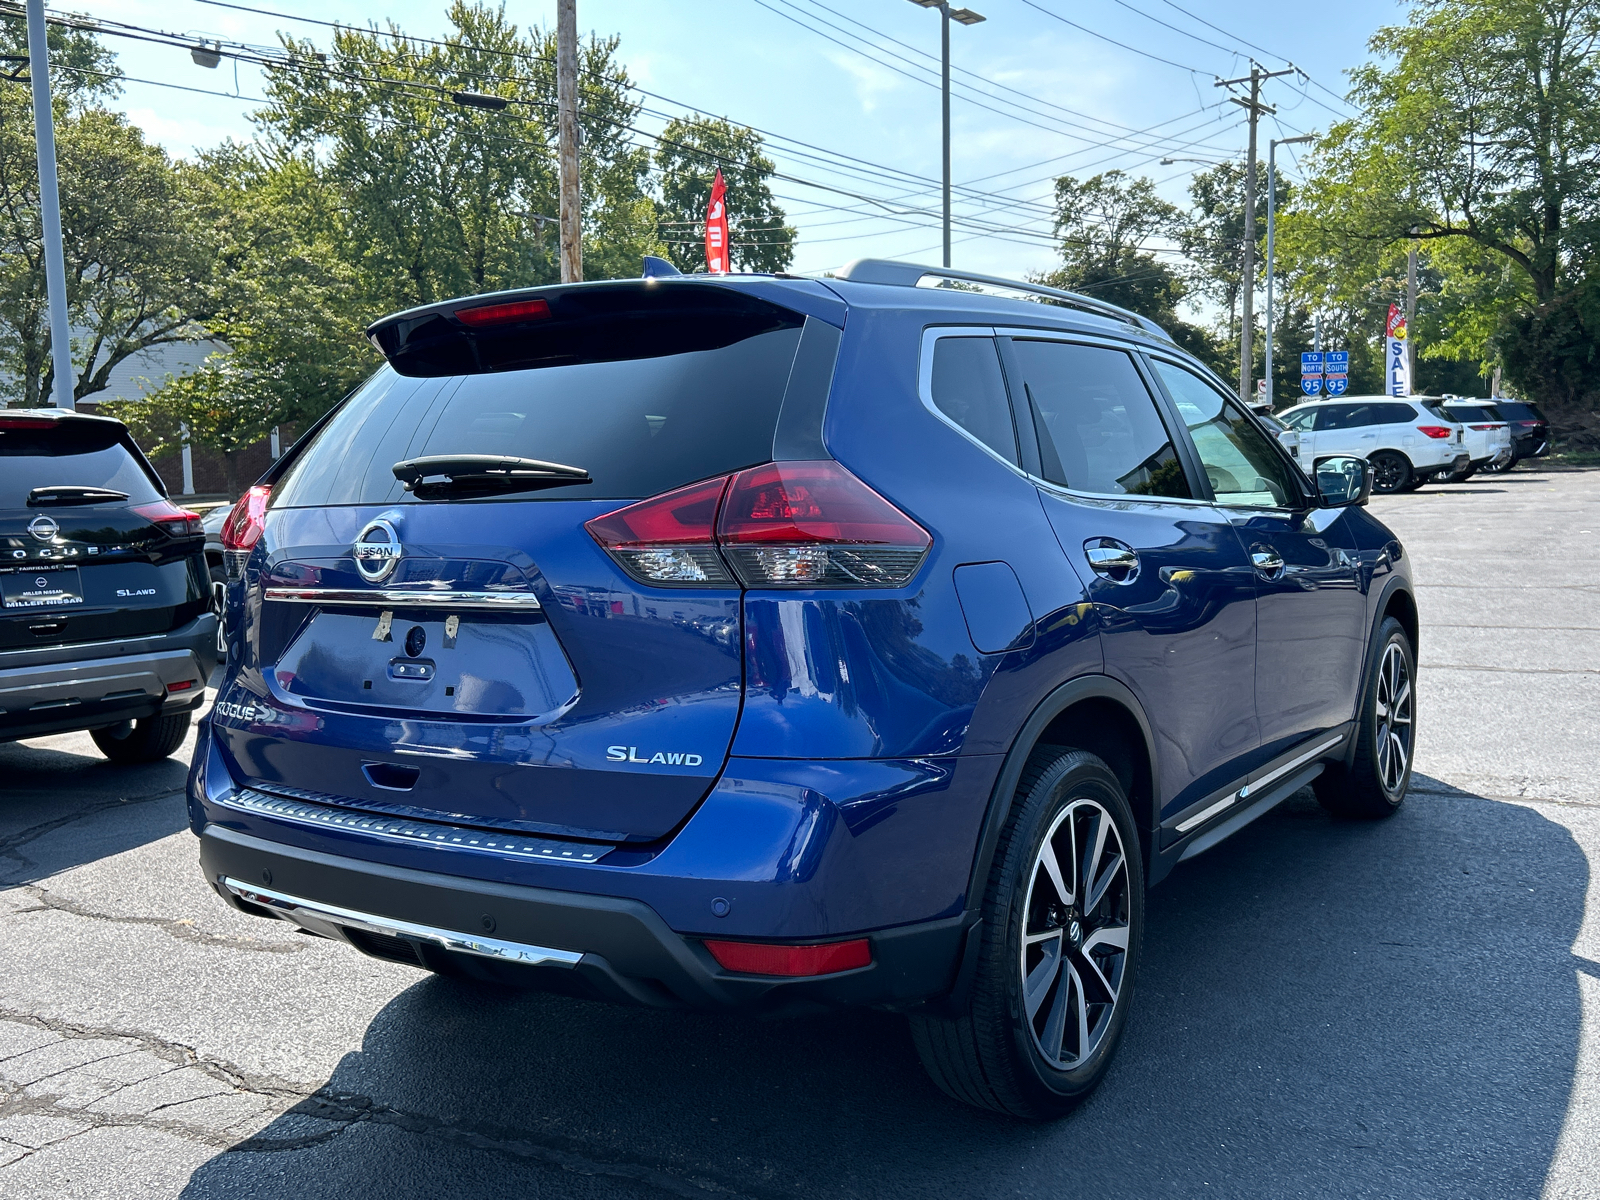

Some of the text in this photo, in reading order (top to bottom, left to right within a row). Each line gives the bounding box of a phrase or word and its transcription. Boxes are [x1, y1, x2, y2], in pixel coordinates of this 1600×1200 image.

[1331, 353, 1343, 361] TO
[1302, 364, 1323, 372] NORTH
[1326, 364, 1348, 372] SOUTH
[1391, 342, 1404, 396] SALE
[1304, 381, 1320, 392] 95
[1328, 380, 1345, 392] 95
[355, 546, 394, 557] NISSAN
[6, 597, 84, 608] MILLER NISSAN
[216, 701, 256, 721] ROGUE
